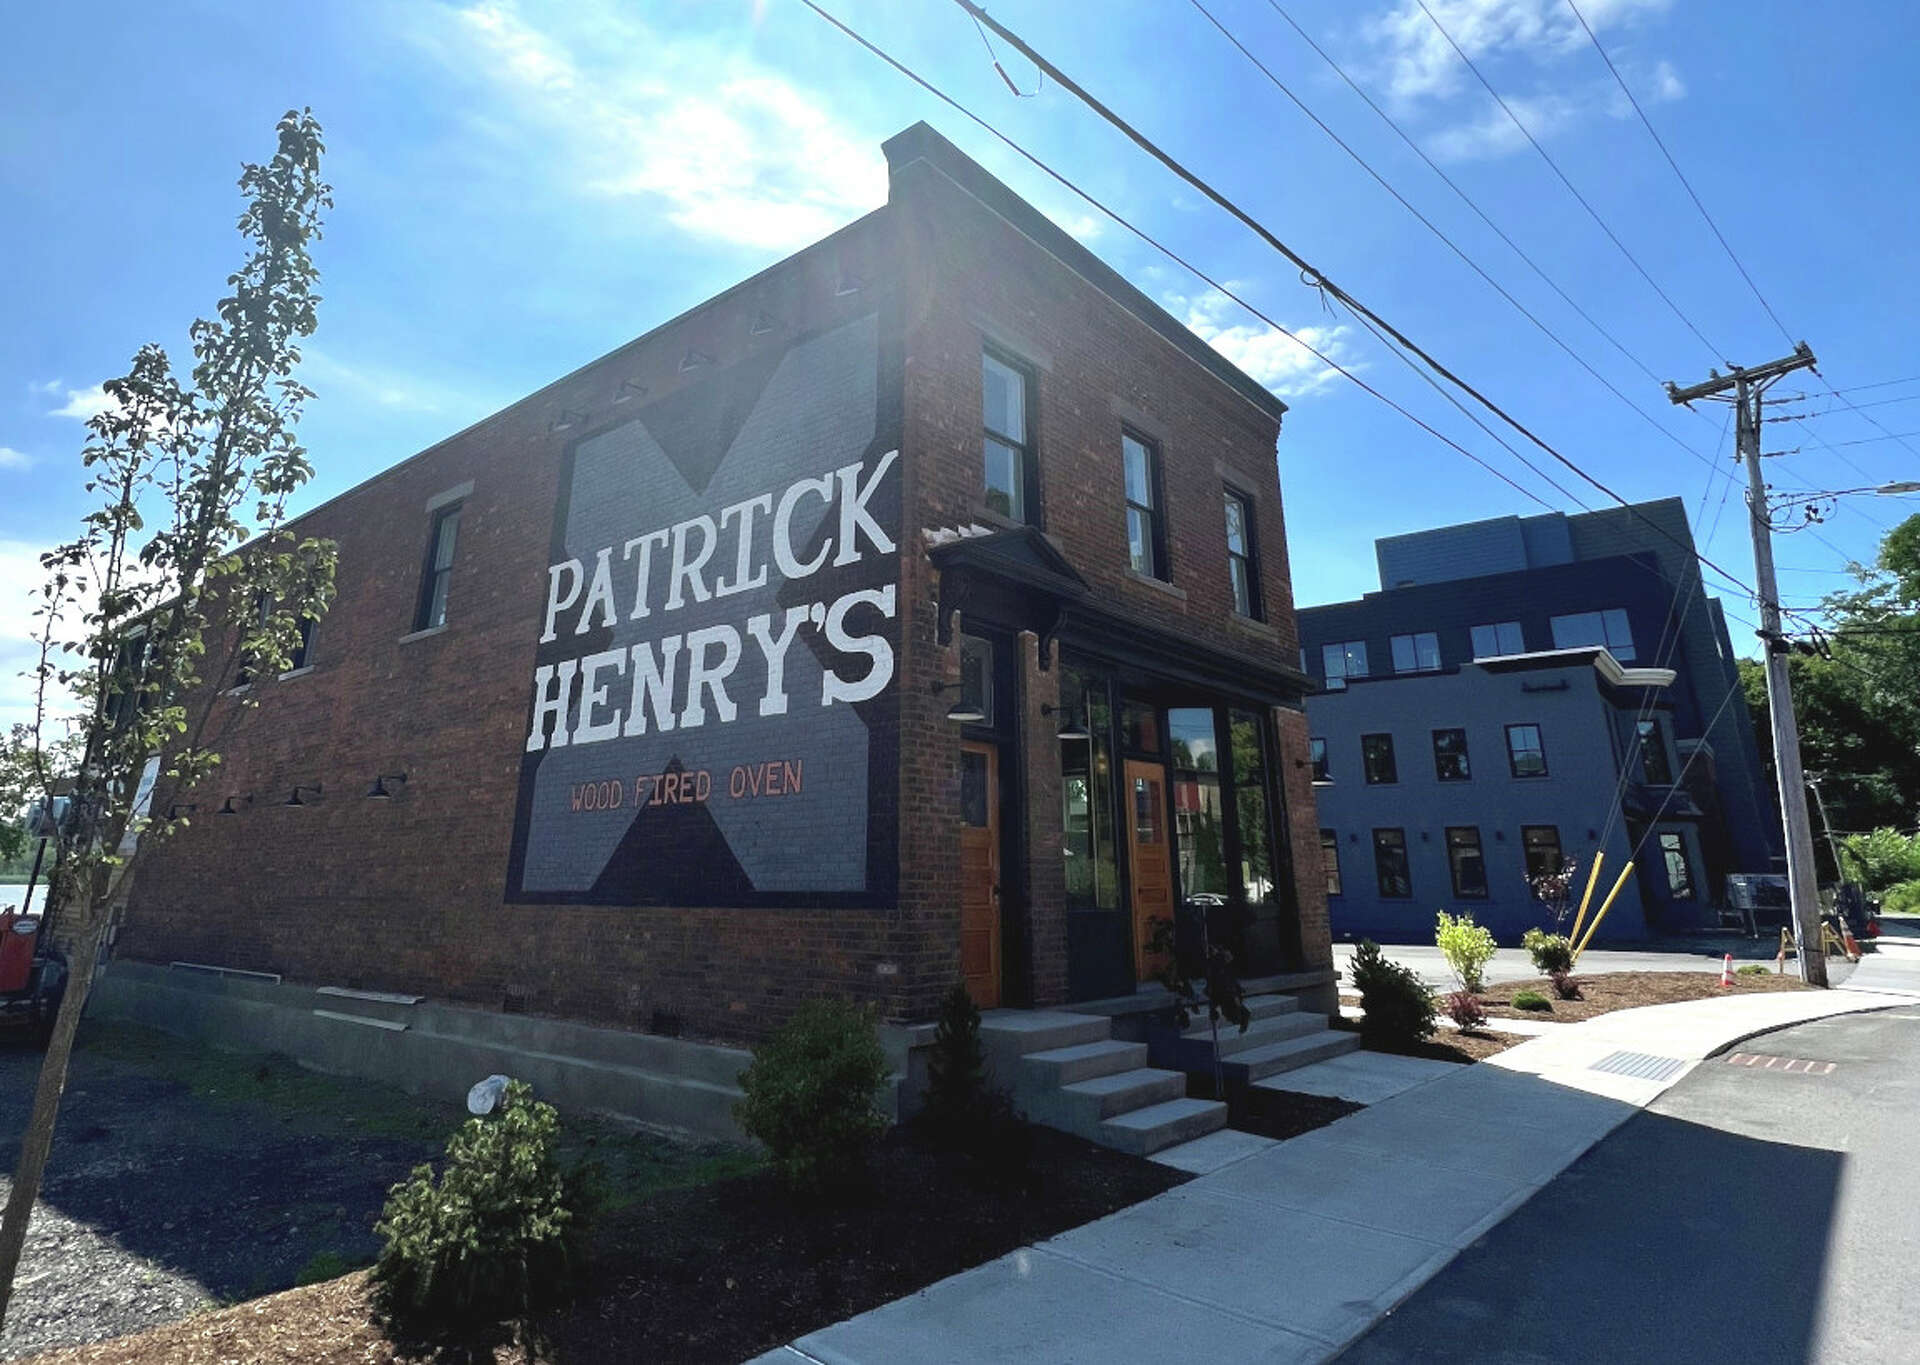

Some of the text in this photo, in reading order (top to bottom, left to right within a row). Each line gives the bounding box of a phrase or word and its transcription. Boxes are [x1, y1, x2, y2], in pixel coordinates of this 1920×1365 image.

[540, 450, 898, 645] PATRICK
[526, 584, 896, 752] HENRY'S
[571, 760, 803, 811] WOOD FIRED OVEN
